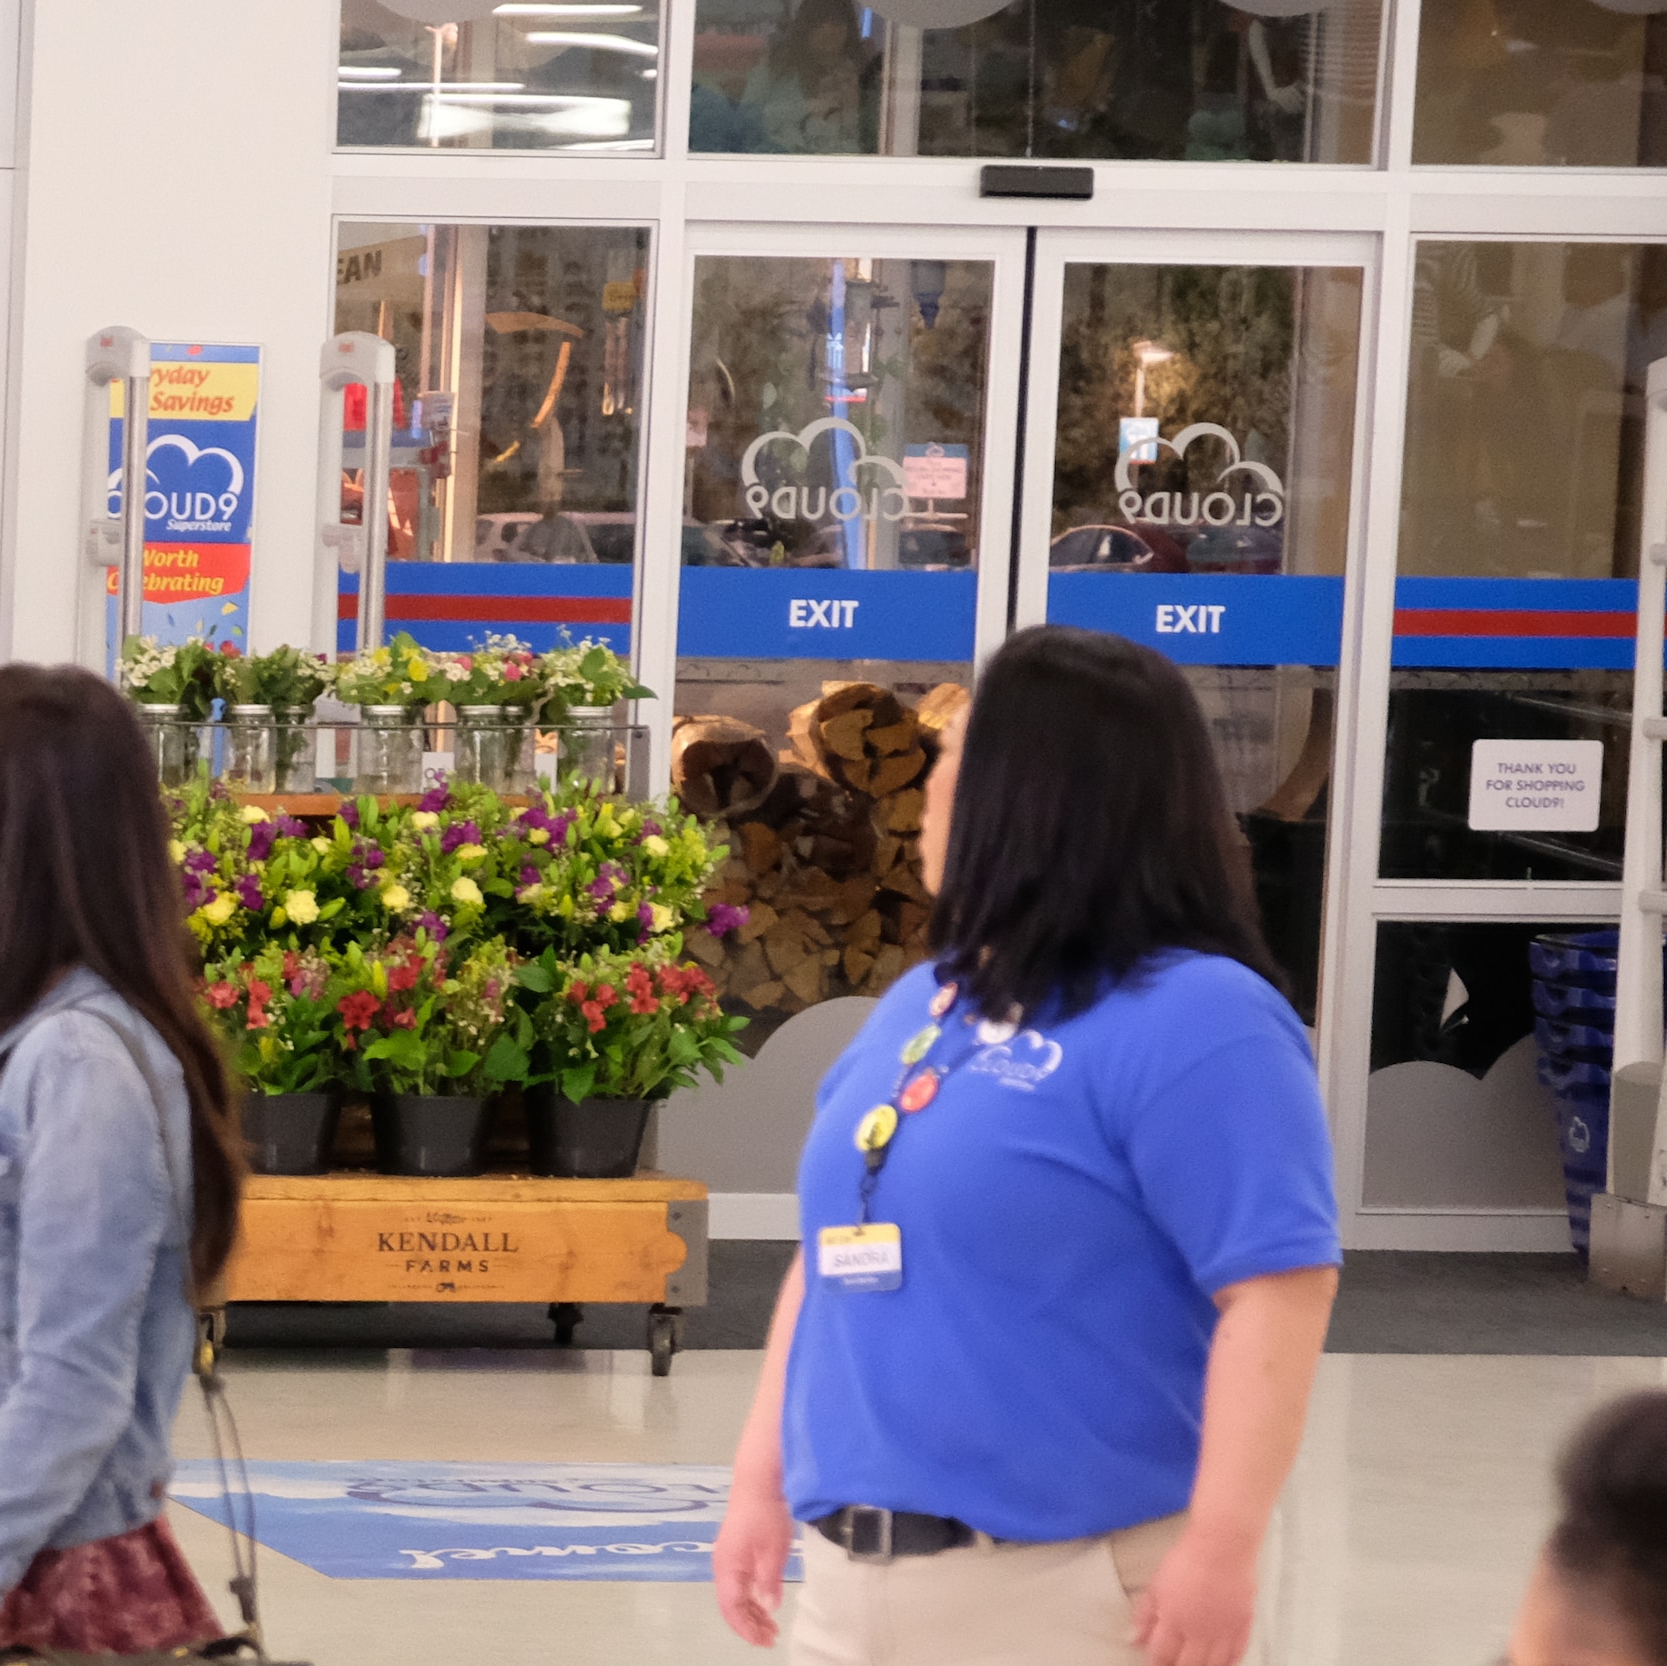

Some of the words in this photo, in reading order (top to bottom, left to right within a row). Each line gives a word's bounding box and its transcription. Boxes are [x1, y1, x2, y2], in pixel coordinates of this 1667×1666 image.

[150, 365, 211, 387] ryday
[150, 391, 235, 415] Savings
[166, 518, 232, 532] Superstore
[108, 572, 225, 595] Cebrating
[788, 599, 859, 629] EXIT
[1155, 605, 1225, 634] EXIT
[1497, 762, 1543, 775] THANK
[1548, 763, 1576, 775] YOU
[1486, 780, 1513, 791] FOR
[1516, 780, 1586, 791] SHOPPING
[377, 1232, 519, 1252] KENDALL
[405, 1259, 489, 1273] FARMS
[347, 1482, 730, 1495] LOUD9
[397, 1540, 714, 1570] come!
